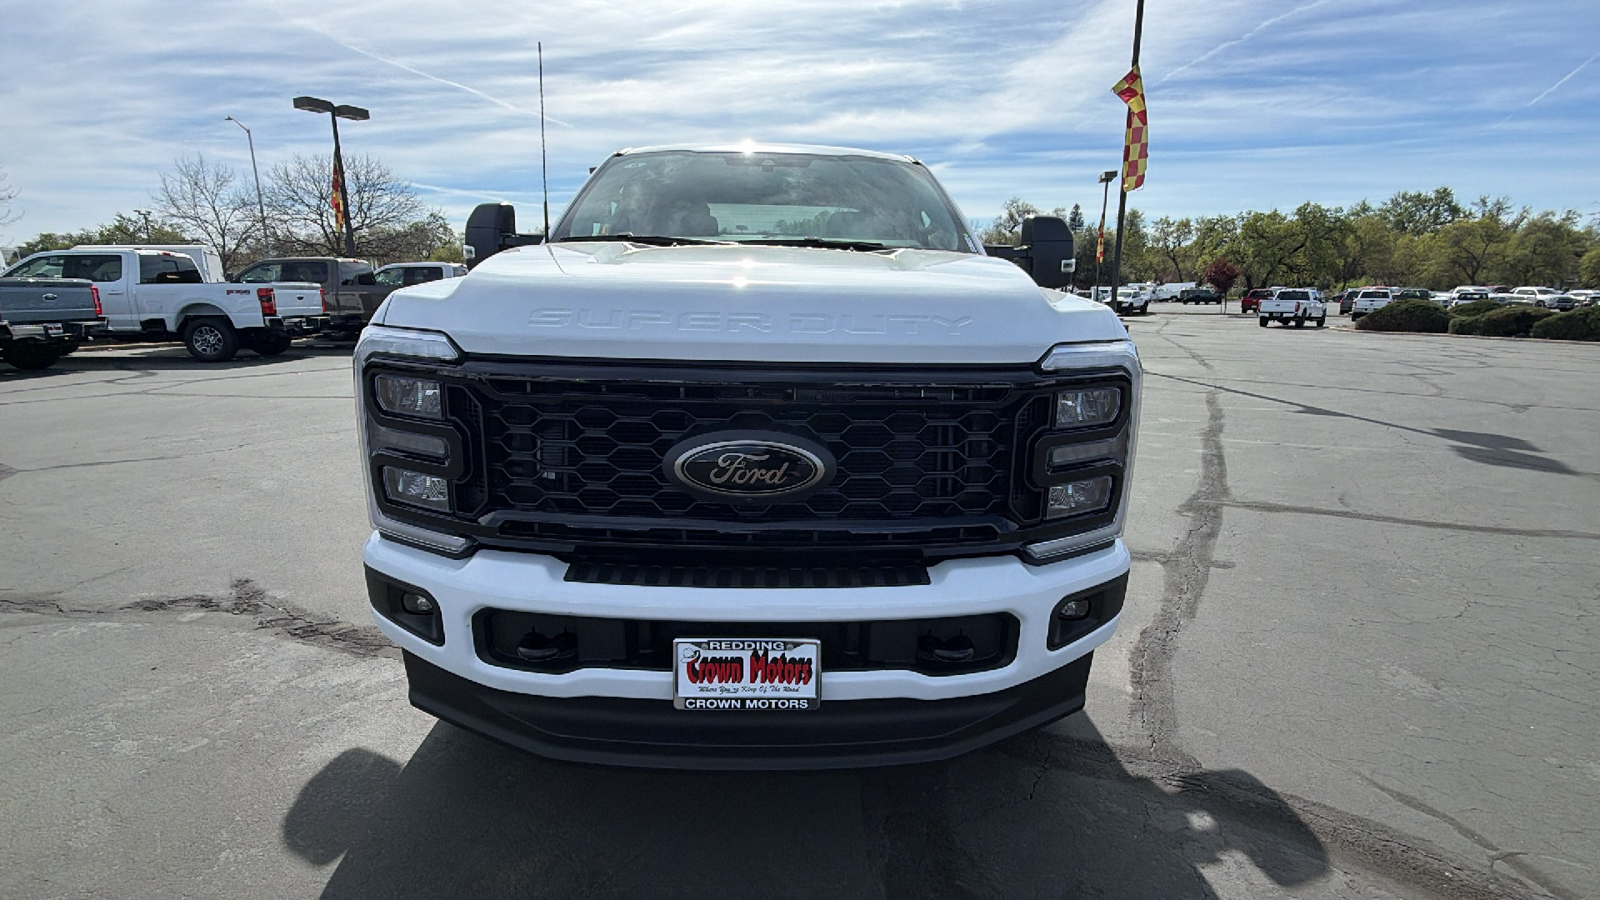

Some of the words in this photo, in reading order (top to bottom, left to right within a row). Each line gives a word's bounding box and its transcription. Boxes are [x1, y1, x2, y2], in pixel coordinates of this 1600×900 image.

[528, 308, 772, 333] SUPER
[790, 313, 973, 335] DUTY
[709, 452, 789, 485] Ford
[709, 641, 785, 650] REDDING
[686, 655, 744, 684] Crown
[750, 650, 812, 685] Motors
[685, 699, 741, 709] CROWN
[745, 699, 809, 709] MOTORS
